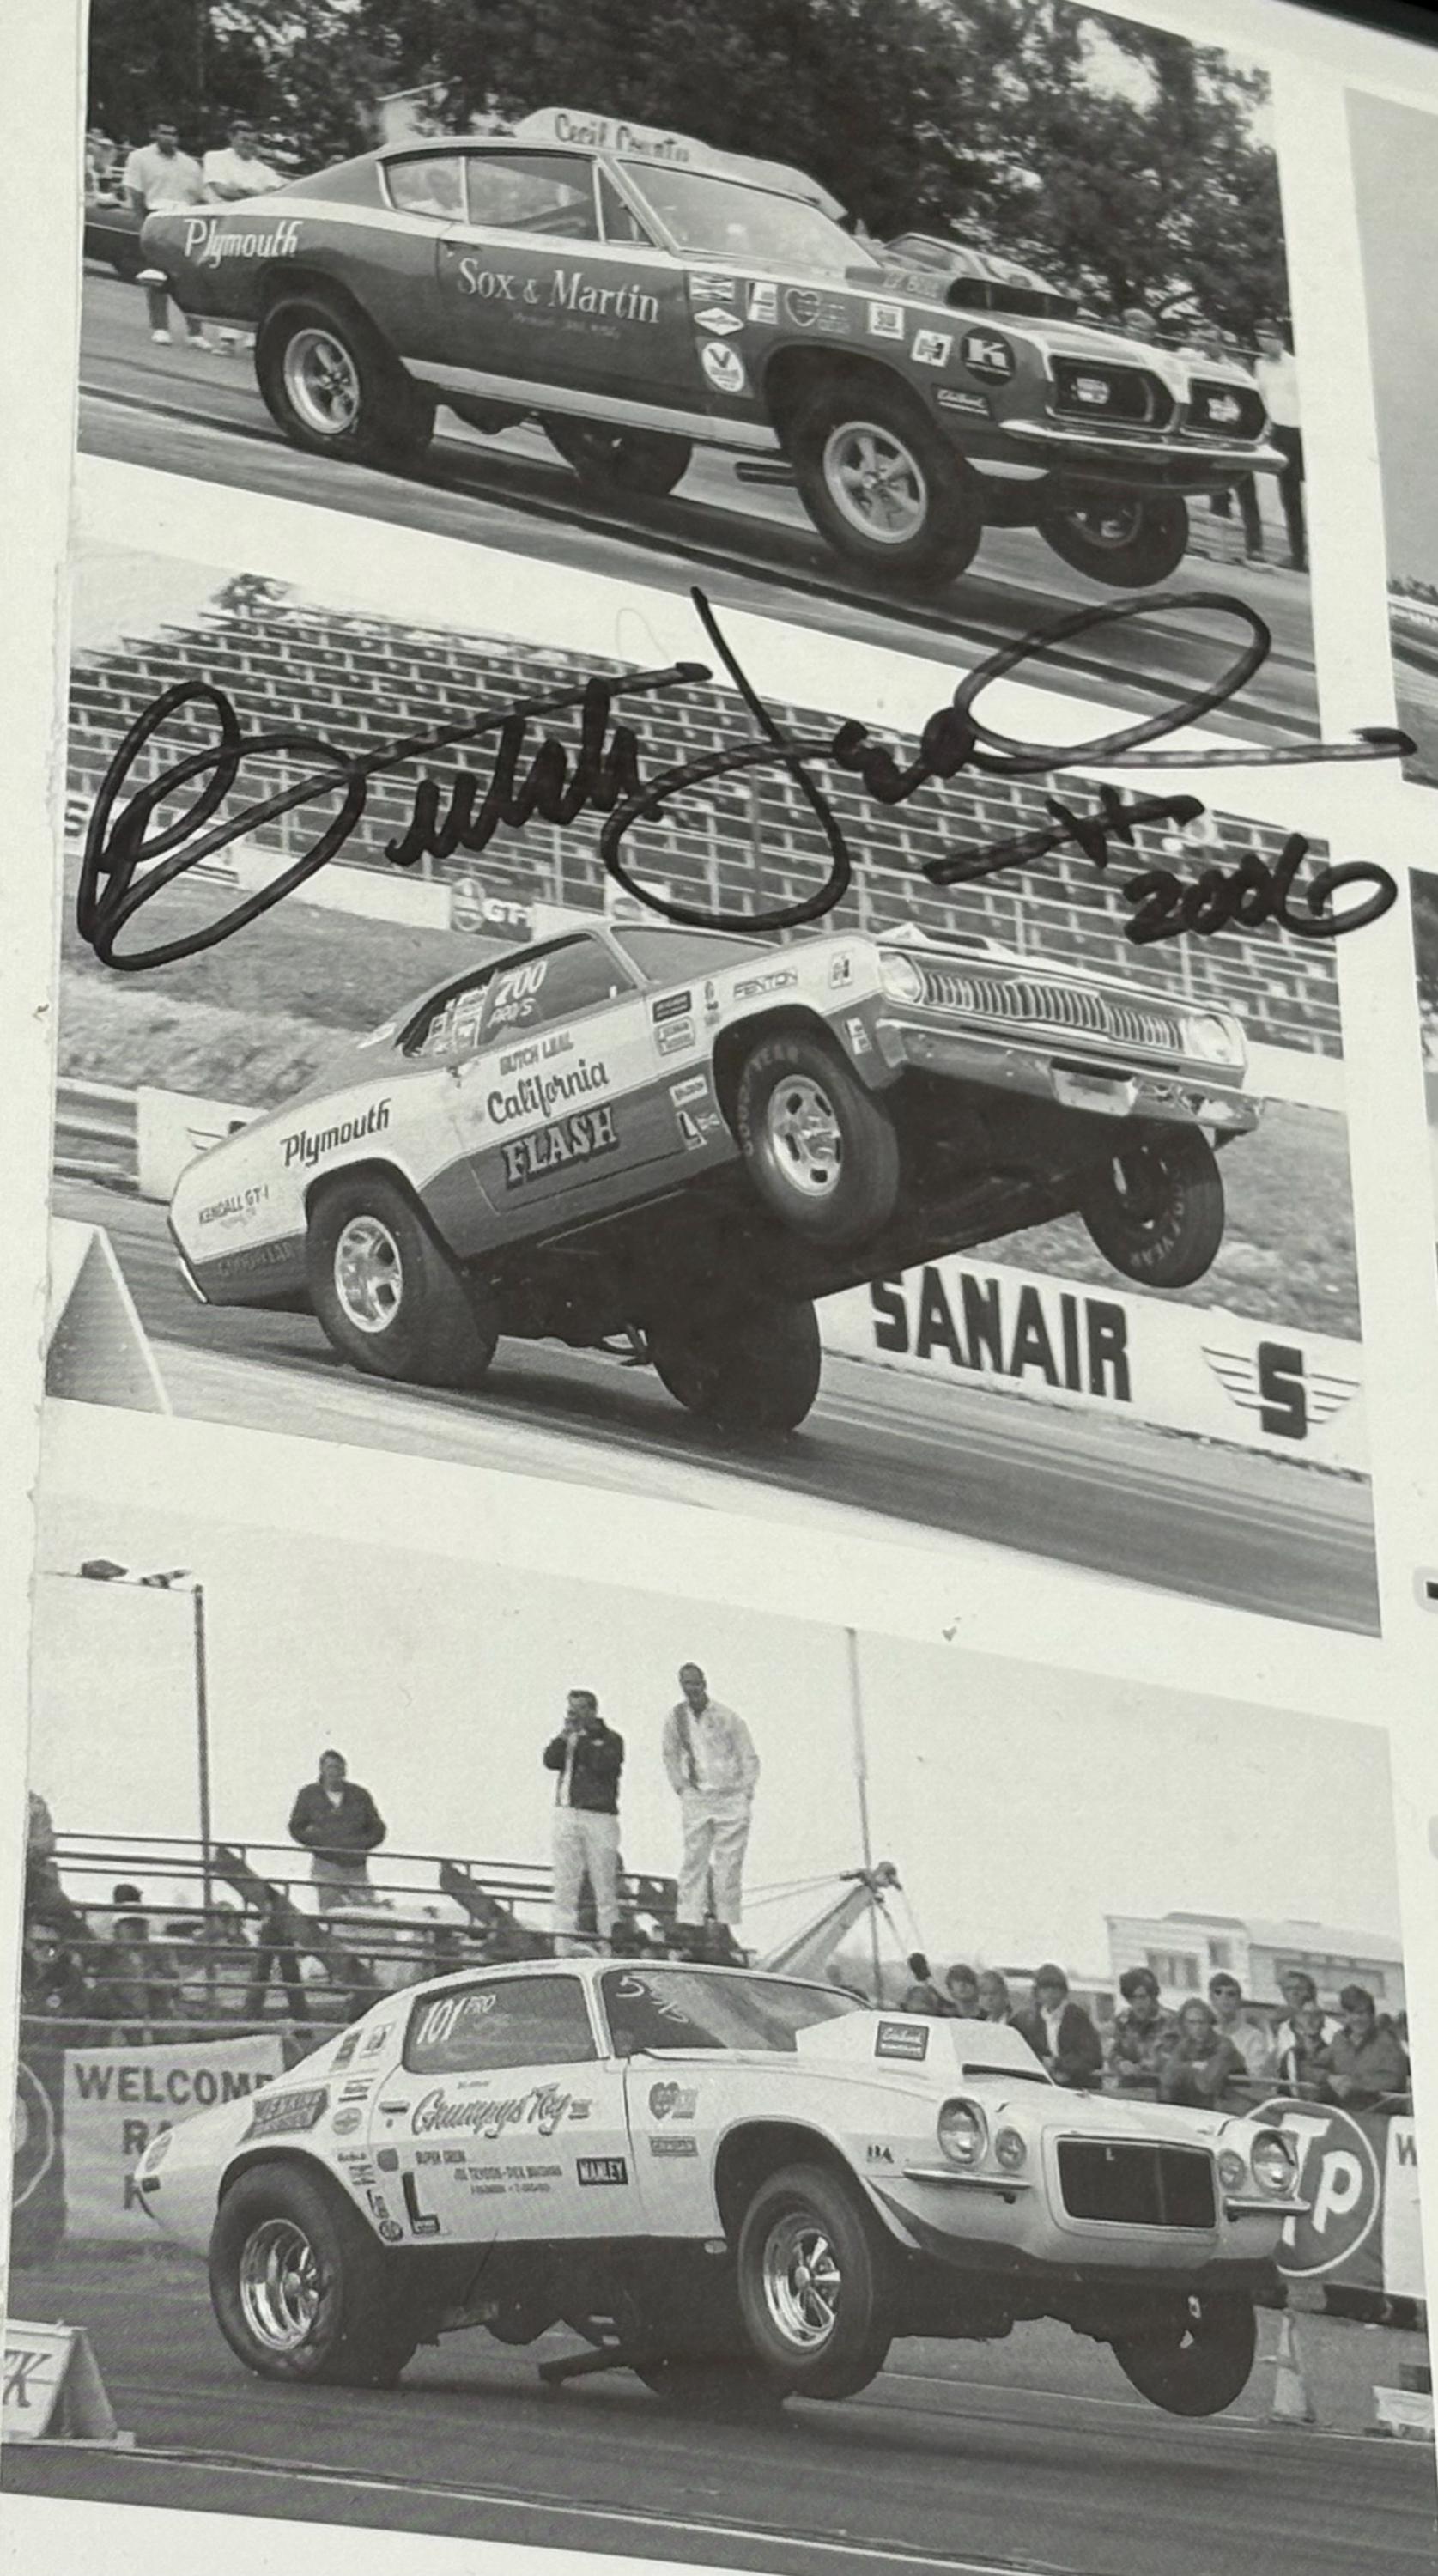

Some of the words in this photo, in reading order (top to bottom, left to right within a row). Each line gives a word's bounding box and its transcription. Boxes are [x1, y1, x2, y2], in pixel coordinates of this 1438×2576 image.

[183, 218, 303, 269] Plymouth
[458, 257, 515, 301] Sox
[523, 278, 541, 304] &
[548, 269, 659, 324] Martin
[1121, 831, 1399, 946] 2006
[494, 959, 548, 1006] 700
[487, 1057, 610, 1125] California
[499, 1044, 538, 1077] BUTCH
[280, 1097, 392, 1168] Plymouth
[501, 1102, 621, 1192] FLASH
[870, 1264, 1133, 1403] SANAIR
[416, 1998, 466, 2044] 101
[1277, 2111, 1363, 2248] TP
